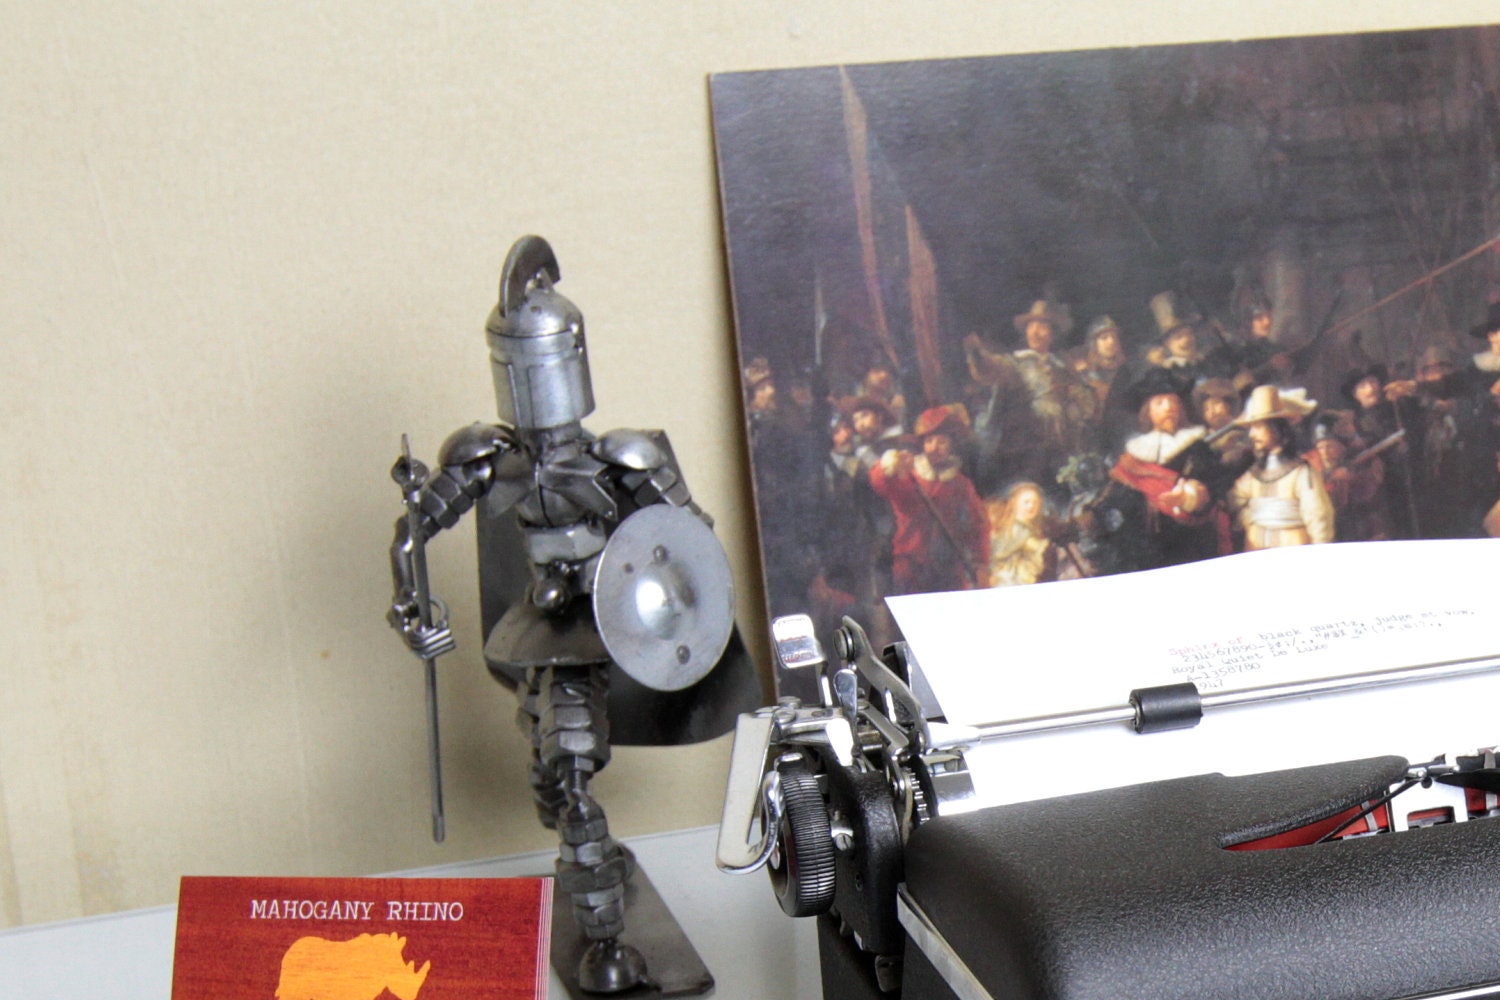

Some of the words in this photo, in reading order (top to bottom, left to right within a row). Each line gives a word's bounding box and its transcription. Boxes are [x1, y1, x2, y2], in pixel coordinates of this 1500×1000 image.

[1257, 628, 1300, 641] black
[249, 899, 375, 922] MAHOGANY
[386, 901, 465, 922] RHINO
